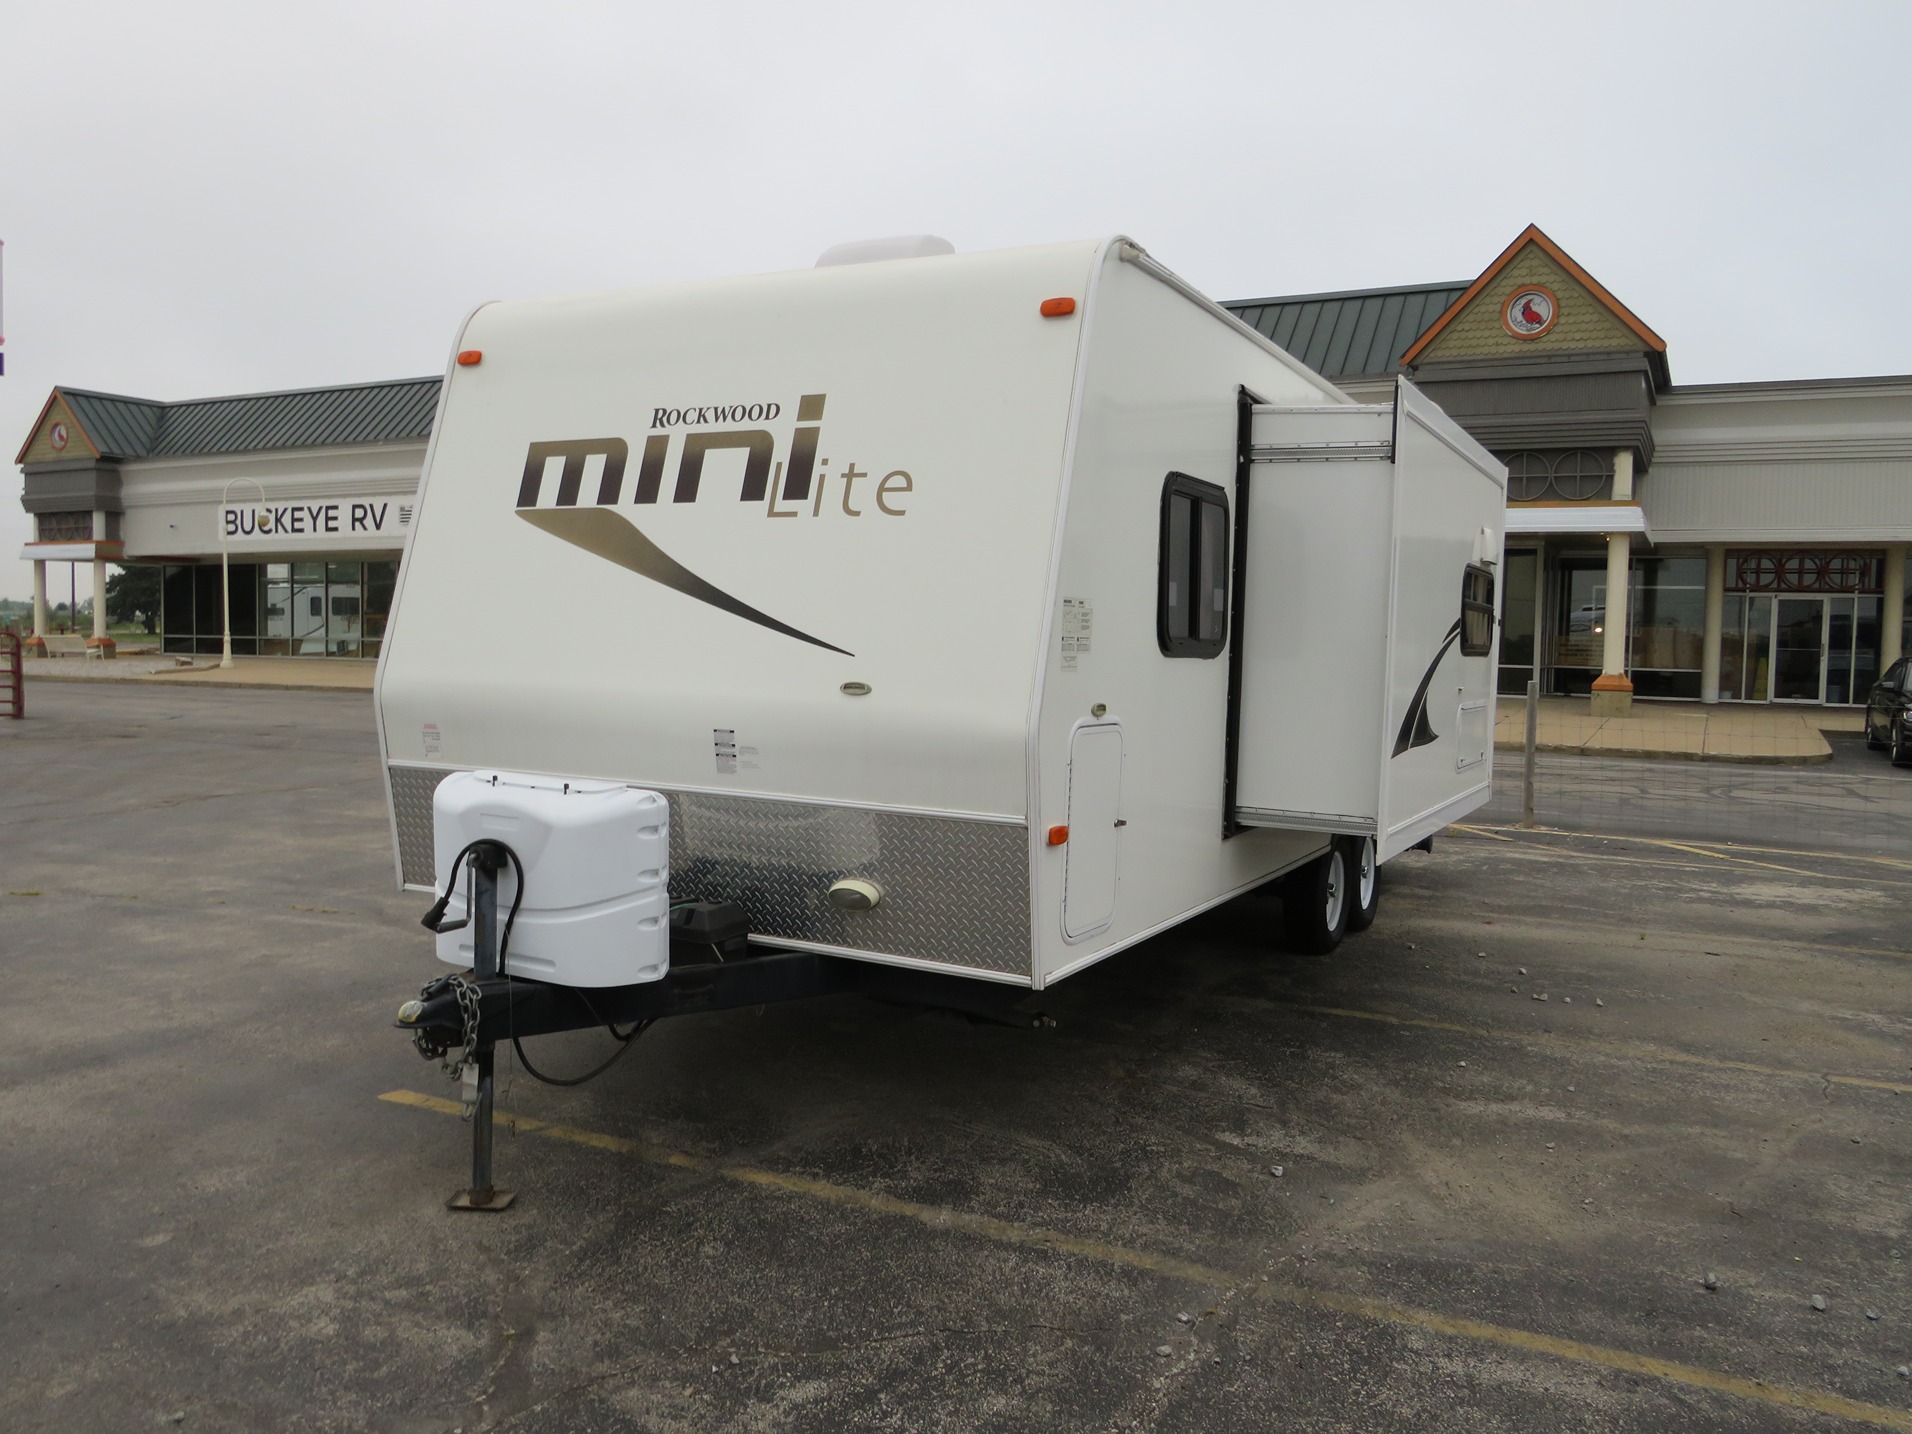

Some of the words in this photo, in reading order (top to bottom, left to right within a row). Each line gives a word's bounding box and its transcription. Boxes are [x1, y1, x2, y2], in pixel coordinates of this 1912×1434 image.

[649, 402, 781, 429] ROCKWOOD
[516, 393, 827, 508] mini
[766, 457, 914, 518] Lite
[225, 504, 340, 536] BUCKEYE
[351, 502, 389, 532] RV
